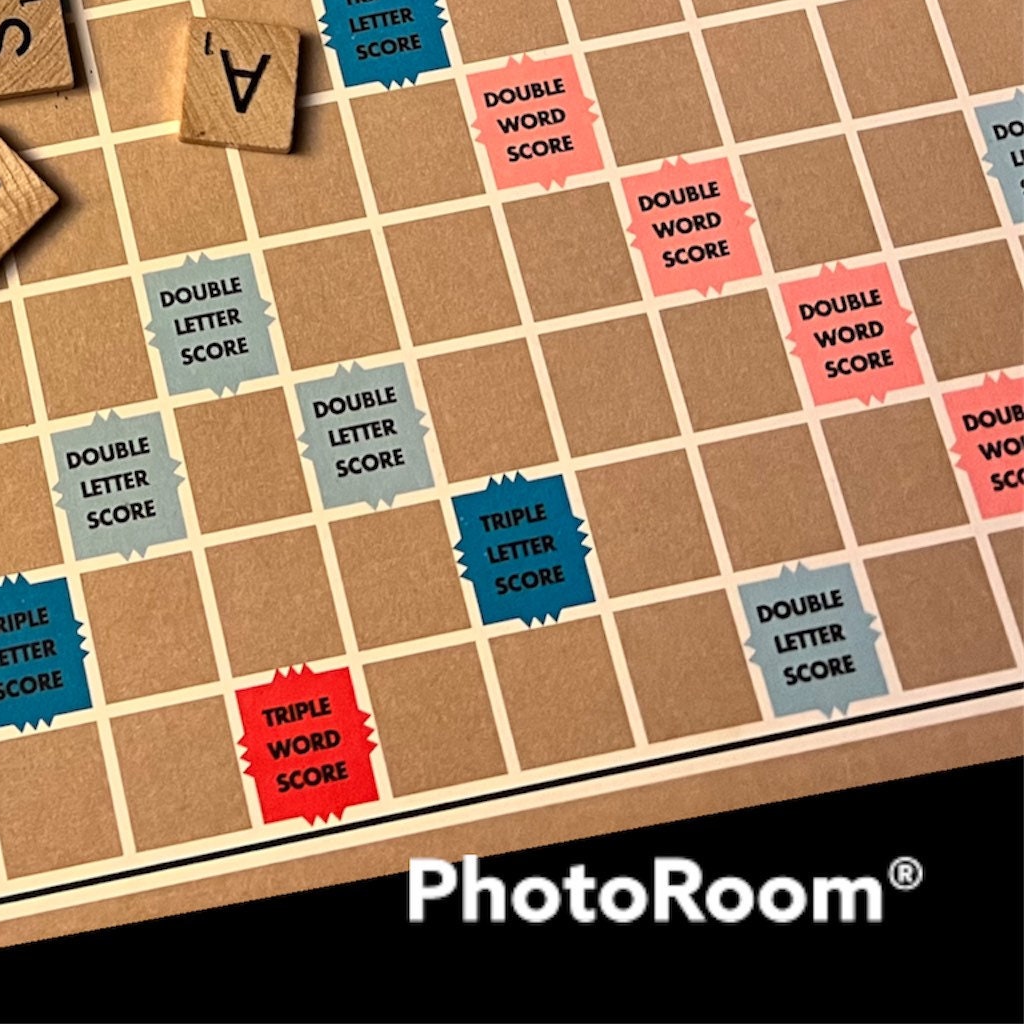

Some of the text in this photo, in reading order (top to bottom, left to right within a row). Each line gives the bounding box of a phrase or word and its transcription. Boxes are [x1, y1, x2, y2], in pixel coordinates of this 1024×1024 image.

[349, 7, 414, 33] LETTER
[355, 33, 422, 60] SCORE
[483, 78, 566, 108] DOUBLE
[496, 108, 566, 134] WORD
[506, 135, 574, 162] SCORE
[159, 276, 243, 308] DOUBLE
[798, 288, 883, 321] DOUBLE
[174, 308, 242, 336] LETTER
[813, 320, 884, 349] WORD
[181, 337, 249, 366] SCORE
[824, 349, 894, 378] SCORE
[312, 386, 398, 419] DOUBLE
[328, 418, 398, 447] LETTER
[335, 448, 405, 478] SCORE
[479, 503, 547, 532] TRIPLE
[486, 534, 557, 564] LETTER
[495, 564, 565, 595] SCORE
[756, 589, 844, 624] DOUBLE
[774, 623, 846, 654] LETTER
[782, 654, 856, 687] SCORE
[261, 696, 332, 727] TRIPLE
[267, 729, 341, 760] WORD
[276, 760, 349, 793] SCORE
